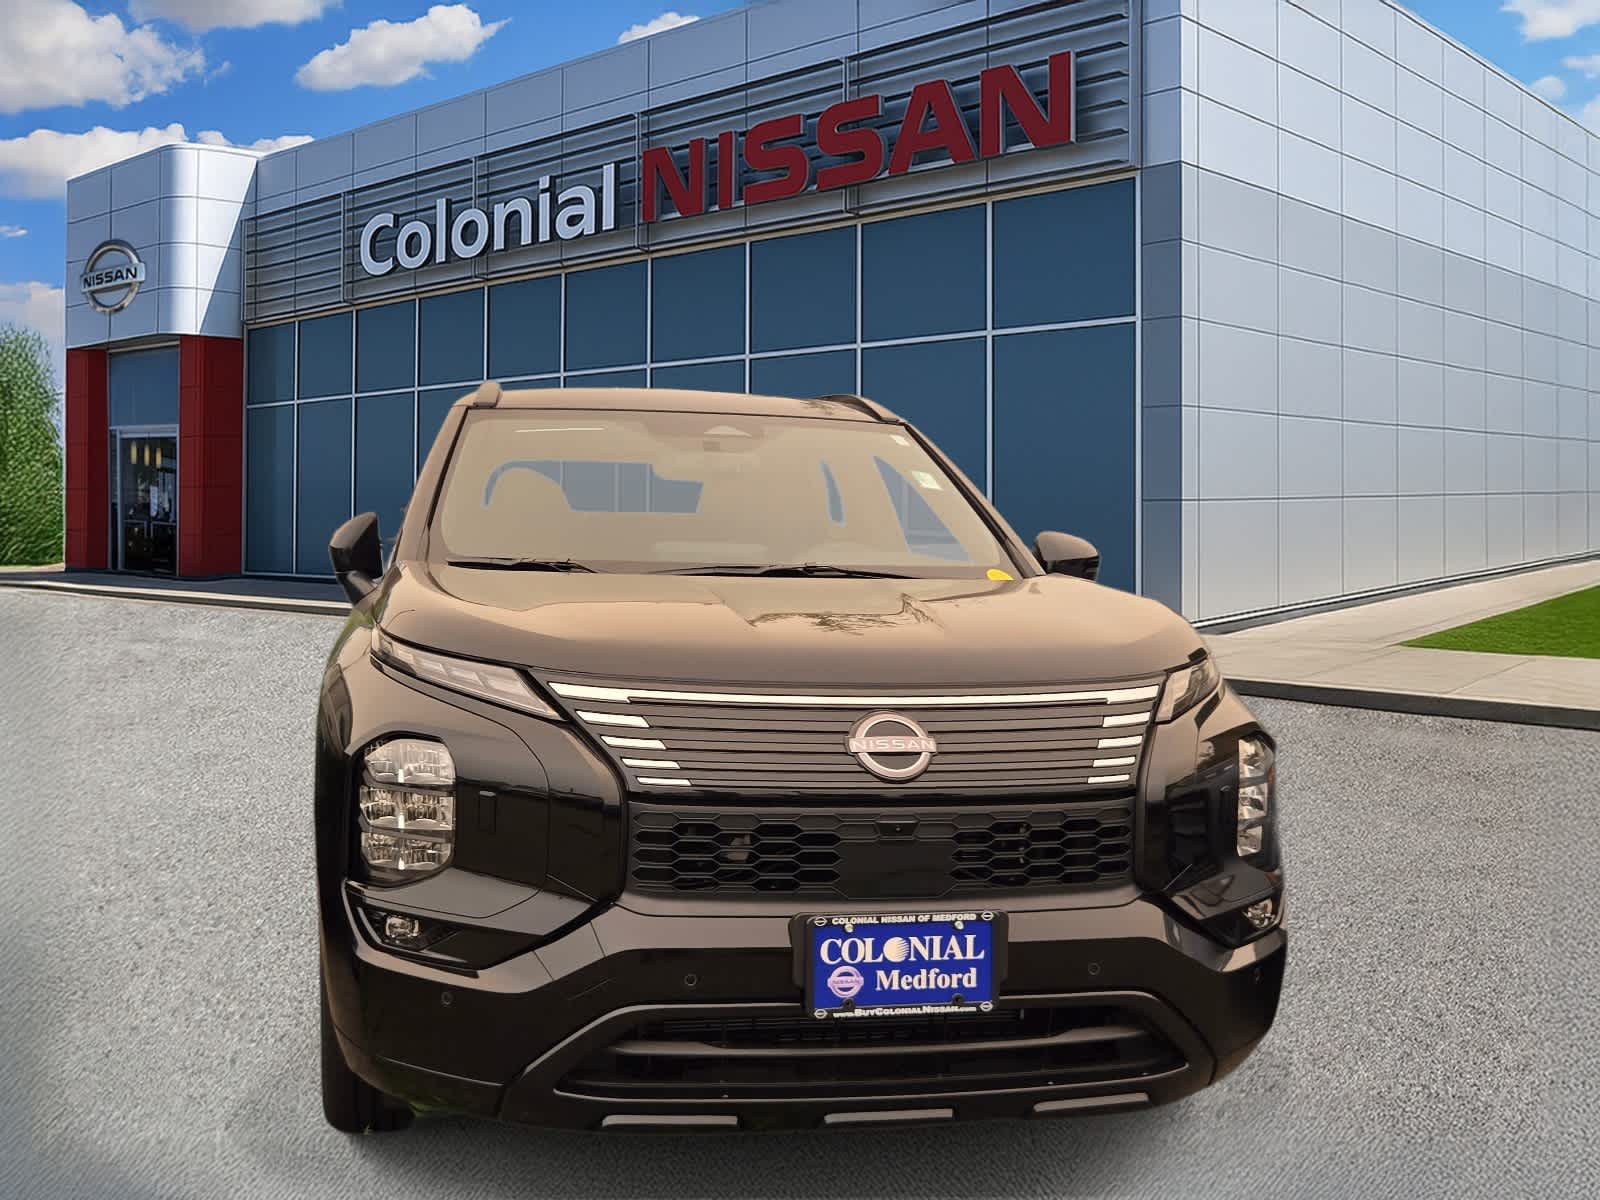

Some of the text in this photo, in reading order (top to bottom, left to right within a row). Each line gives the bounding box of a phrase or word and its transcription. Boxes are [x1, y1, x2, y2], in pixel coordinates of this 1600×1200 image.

[359, 50, 1077, 277] Colonial NISSAN
[83, 266, 137, 288] NISSAN
[851, 739, 935, 751] NISSAN
[831, 913, 977, 925] COLONIAL NISSAN OF MEDFORD
[820, 934, 985, 965] COLONIAL
[875, 967, 978, 991] Medford
